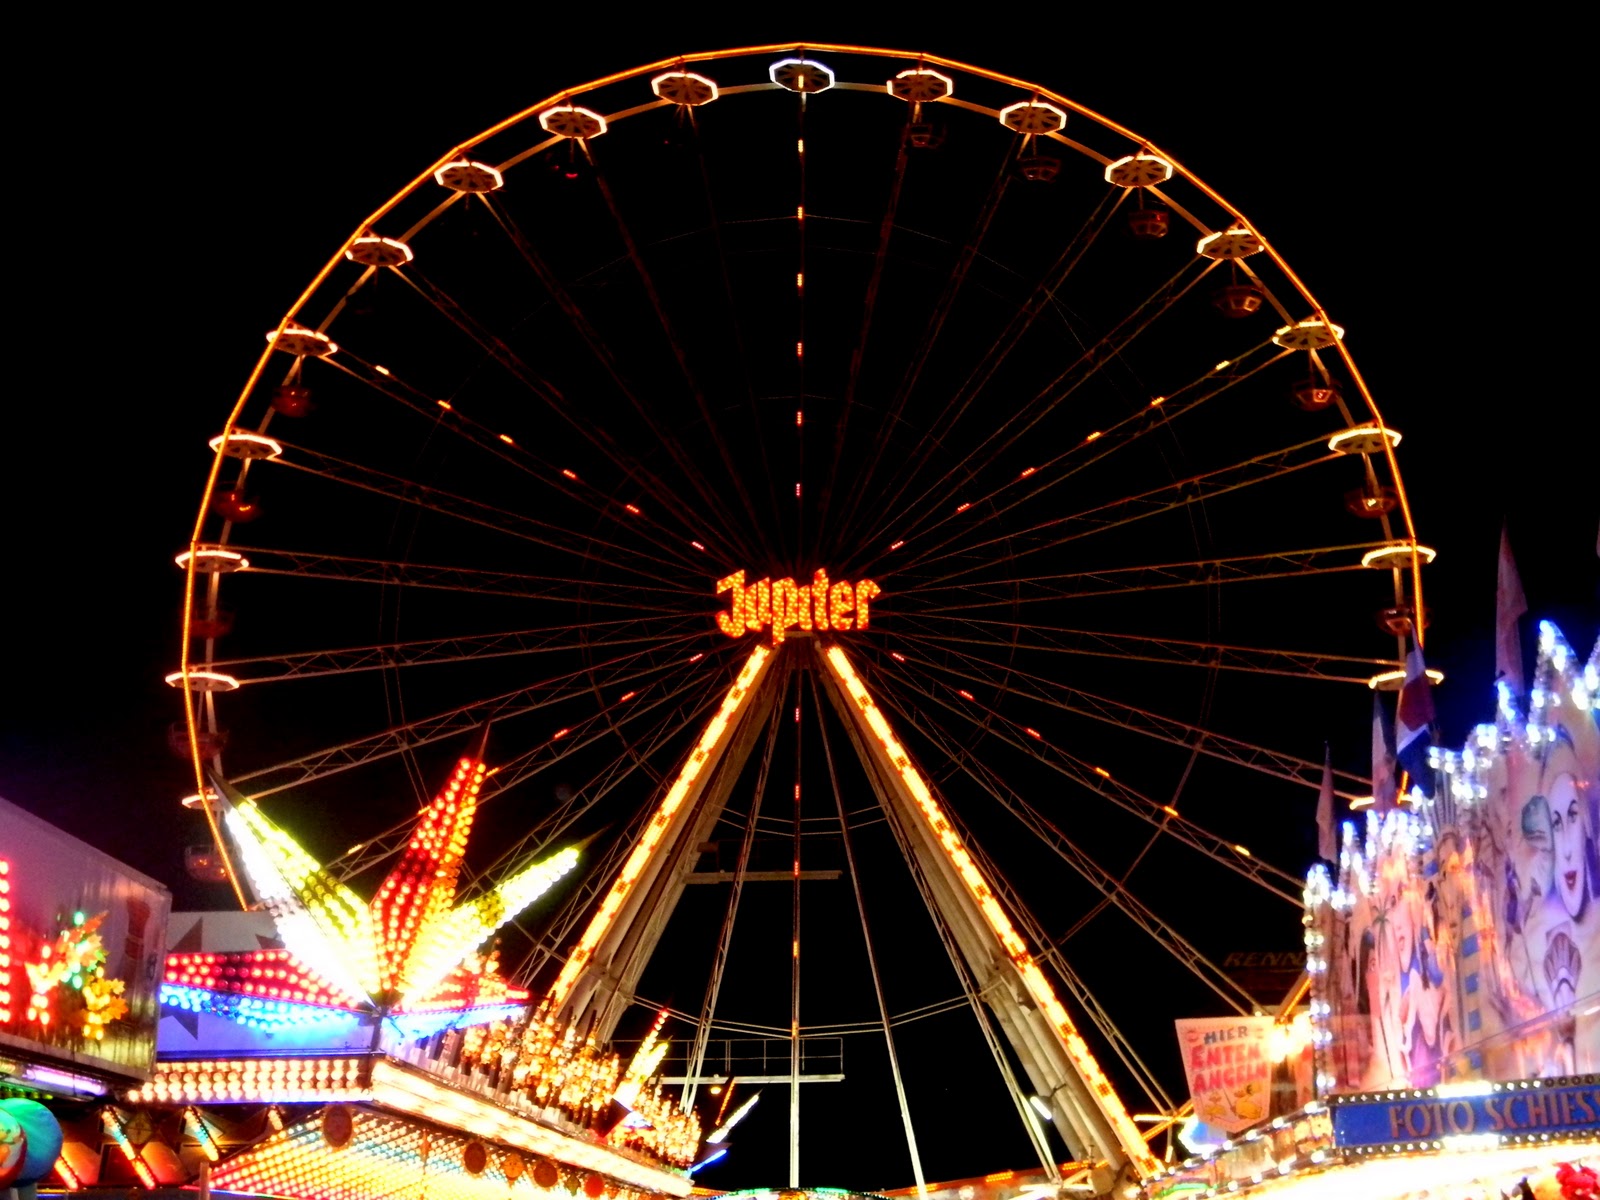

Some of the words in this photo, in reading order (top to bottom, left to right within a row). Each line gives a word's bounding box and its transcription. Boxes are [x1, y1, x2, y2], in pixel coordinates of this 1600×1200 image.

[715, 567, 881, 645] Jupiter
[1204, 1025, 1249, 1045] HIER
[1190, 1043, 1262, 1070] ENTEN
[1193, 1063, 1268, 1095] ANGELN
[1388, 1100, 1475, 1138] FOTO
